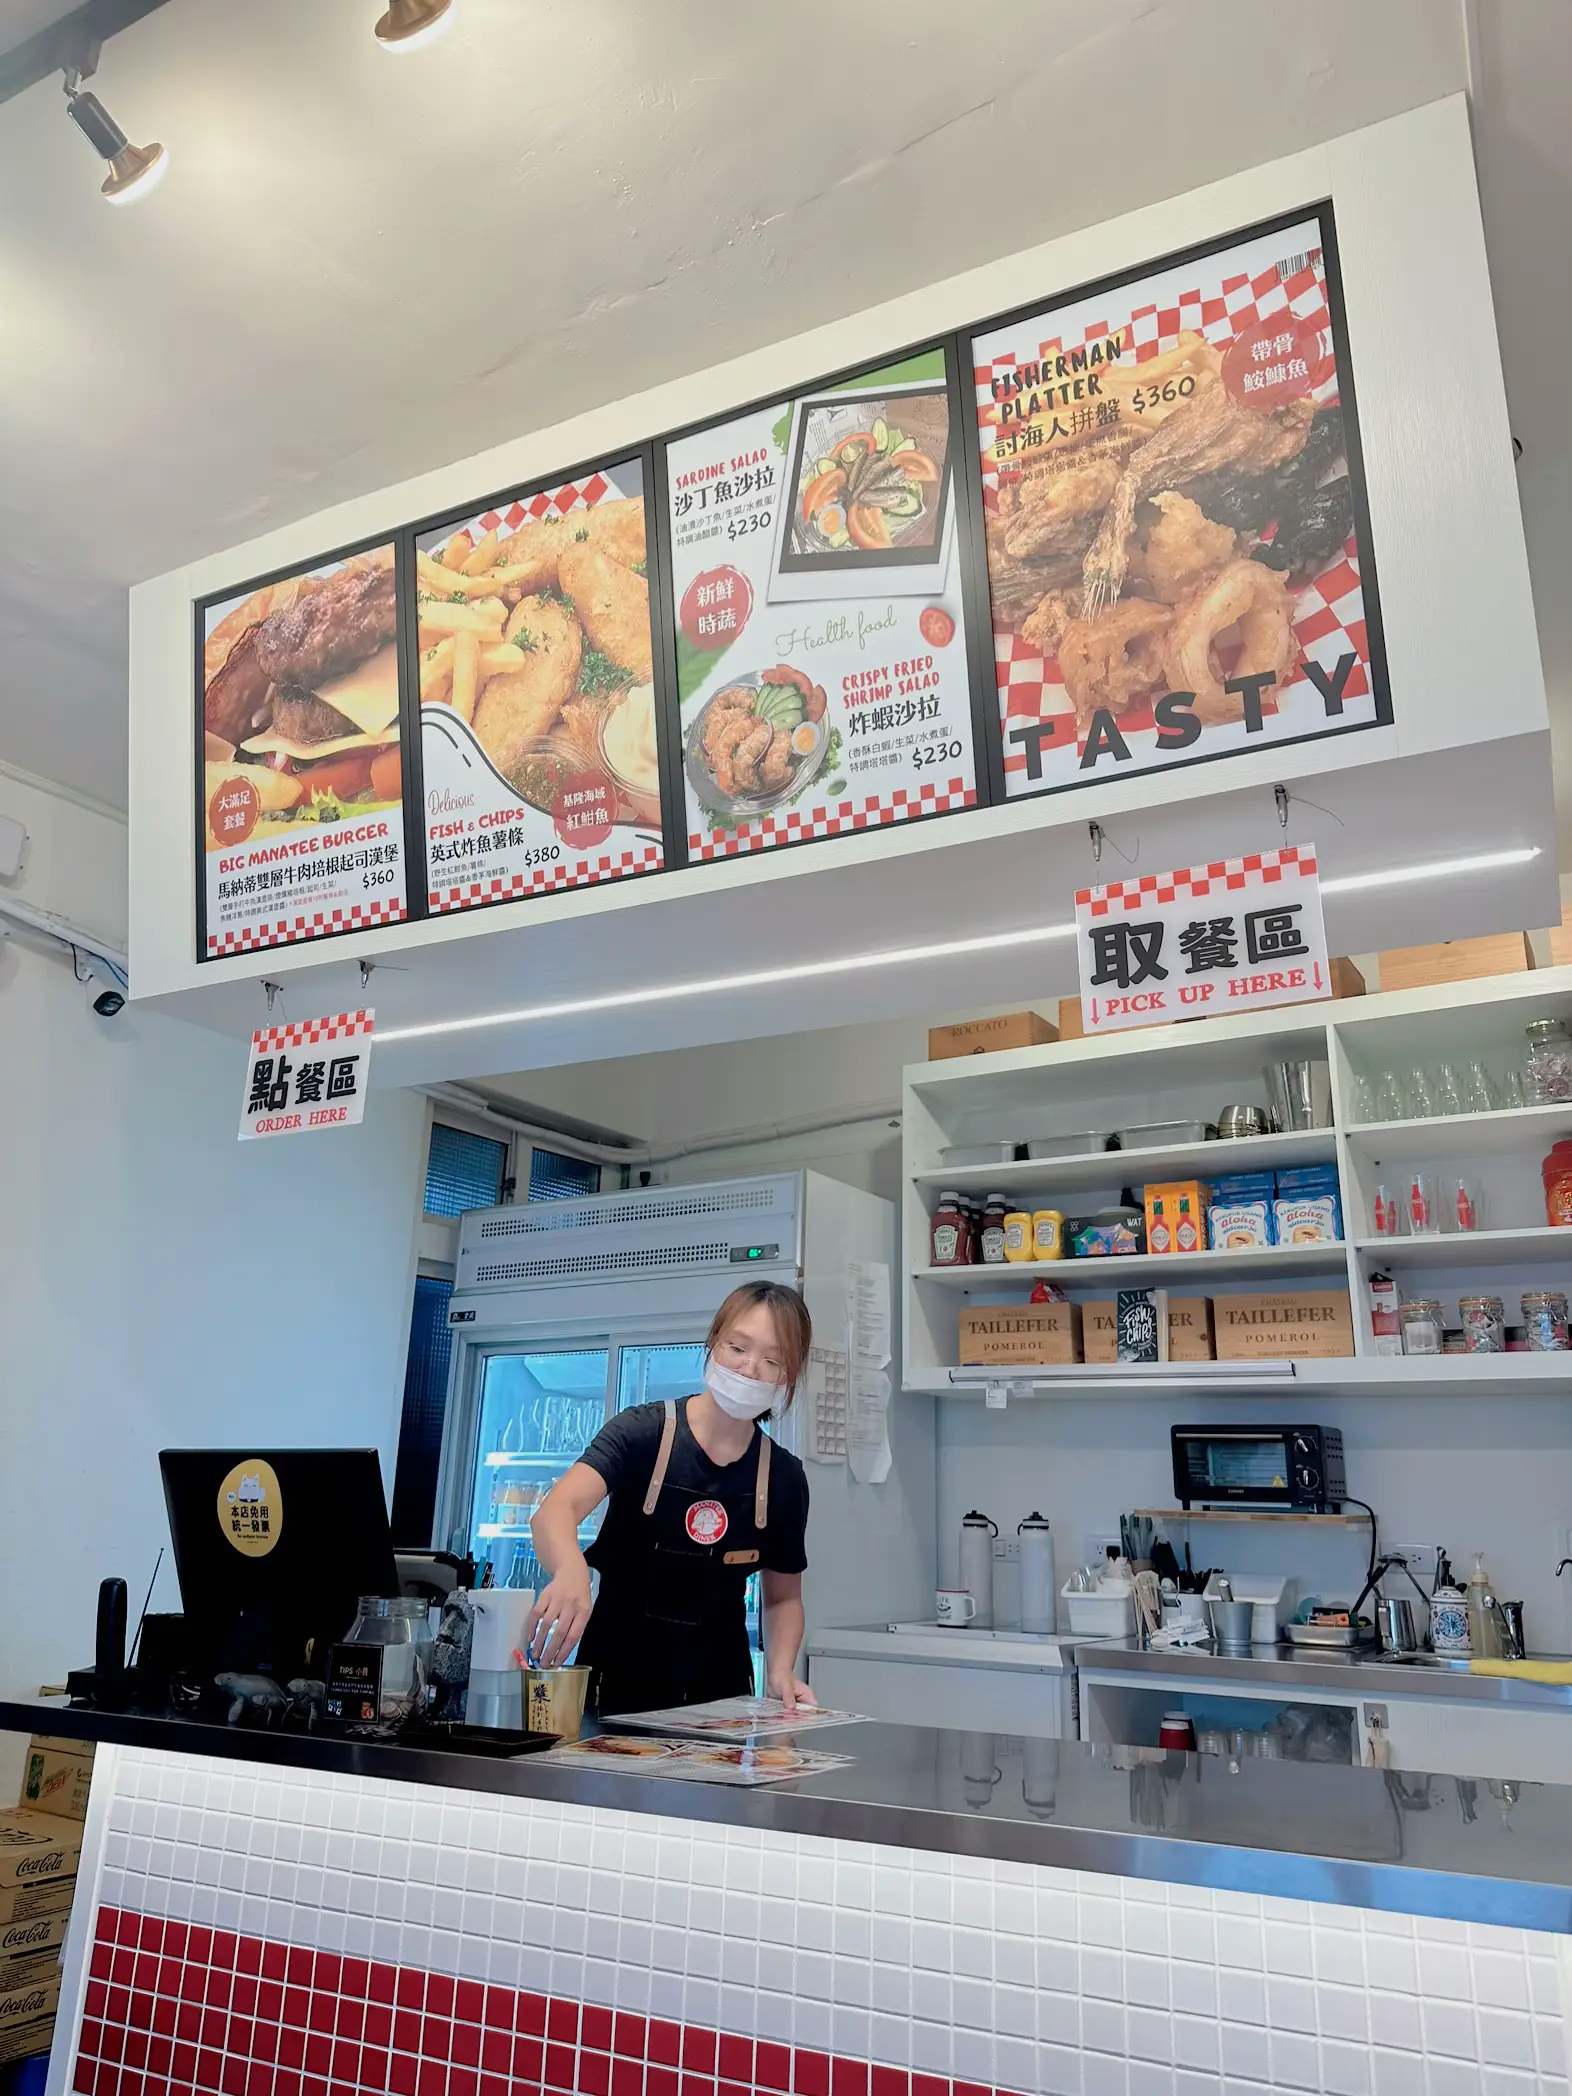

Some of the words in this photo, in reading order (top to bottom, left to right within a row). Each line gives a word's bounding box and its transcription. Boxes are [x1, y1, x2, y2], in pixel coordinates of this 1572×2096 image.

[1250, 332, 1295, 362] 帶骨
[990, 336, 1121, 399] FISHERMAN
[1242, 358, 1309, 394] 鮟鱇魚
[1001, 375, 1103, 425] PLATTER
[1132, 375, 1197, 415] $360
[995, 398, 1121, 459] 討海人拼盤
[676, 461, 726, 490] SARDINE
[730, 448, 768, 472] SALAD
[674, 465, 776, 517] 沙丁魚沙拉
[727, 511, 771, 541] $230
[697, 577, 735, 607] 新鮮
[699, 608, 736, 635] 時蔬
[775, 617, 855, 657] Health
[858, 605, 897, 649] food
[842, 666, 888, 692] CRISPY
[894, 655, 933, 677] FRIED
[843, 684, 893, 709] SHRIMP
[898, 671, 940, 695] SALAD
[849, 694, 942, 737] 炸蝦沙拉
[1009, 652, 1358, 781] TASTY
[912, 740, 963, 770] $230
[218, 790, 250, 812] 大滿足
[428, 788, 475, 816] Delicious
[563, 786, 606, 809] 基隆海域
[223, 812, 246, 831] 套餐
[429, 820, 463, 840] FISH
[478, 808, 525, 829] CHIPS
[219, 854, 245, 874] BIG
[248, 838, 320, 867] MANATEE
[322, 822, 388, 849] BURGER
[430, 827, 524, 864] 英式炸魚薯條
[524, 846, 560, 868] $380
[218, 843, 399, 900] 馬納蒂雙層牛肉培根起司漢堡
[362, 869, 394, 890] $360
[1088, 903, 1310, 989] 取餐區
[1106, 991, 1167, 1017] PICK
[1178, 983, 1215, 1005] UP
[1228, 968, 1307, 997] HERE
[952, 1019, 1008, 1037] ROCCATO
[247, 1055, 360, 1115] 點餐區
[255, 1114, 302, 1133] ORDER
[308, 1106, 348, 1125] HERE
[968, 1318, 1059, 1335] TAILLEFER
[1225, 1307, 1336, 1325] TAILLEFER
[983, 1341, 1045, 1351] POMEROL
[1245, 1332, 1320, 1343] POMEROL
[230, 1505, 269, 1519] 本店免用
[231, 1520, 271, 1533] 統一發票
[340, 1666, 354, 1675] TIPS
[16, 1851, 66, 1877] Coca-Cola
[2, 1920, 54, 1949] Coca-Cola
